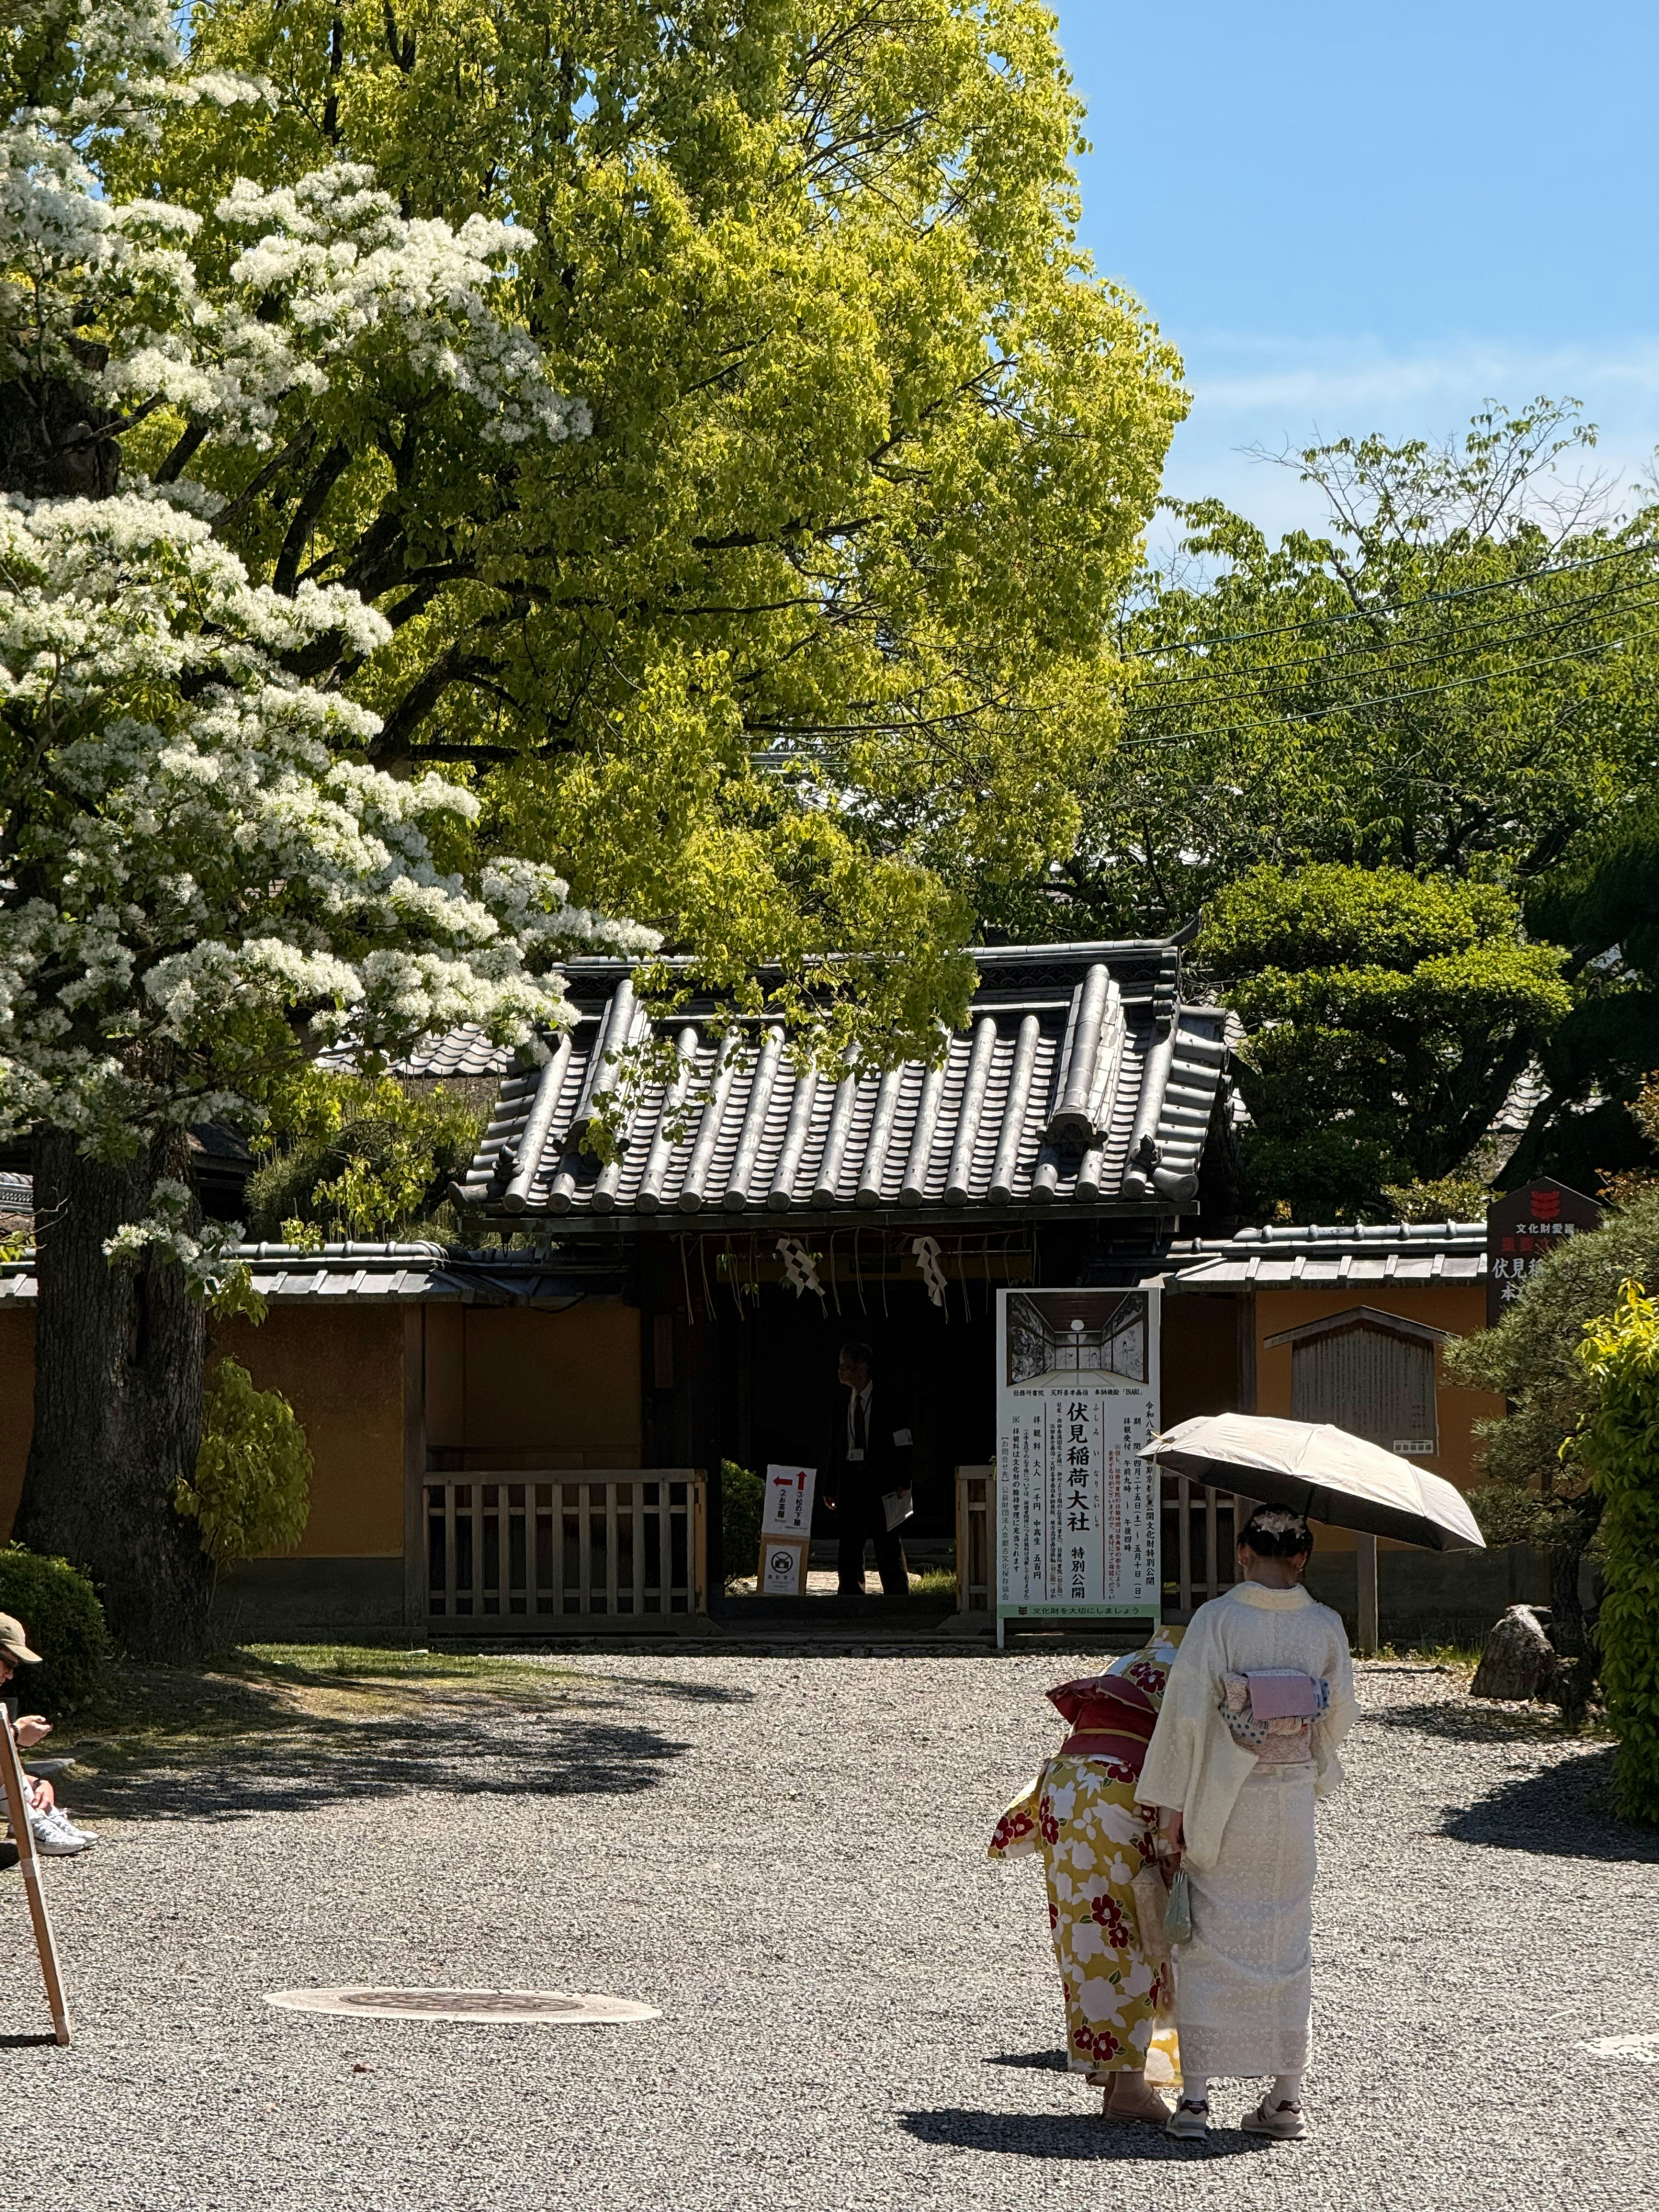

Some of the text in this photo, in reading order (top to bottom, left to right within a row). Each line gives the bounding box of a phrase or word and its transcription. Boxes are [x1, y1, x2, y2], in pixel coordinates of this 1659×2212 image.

[1124, 1417, 1132, 1450] 拝観受付
[1033, 1459, 1042, 1476] 大人
[1124, 1459, 1132, 1493] 午前九時
[1033, 1487, 1041, 1511] 一千円
[1066, 1402, 1091, 1599] 伏見稲荷大社 特別公開
[1033, 1519, 1041, 1545] 中高生
[1124, 1518, 1132, 1552] 午後四時
[1033, 1554, 1042, 1580] 五百円
